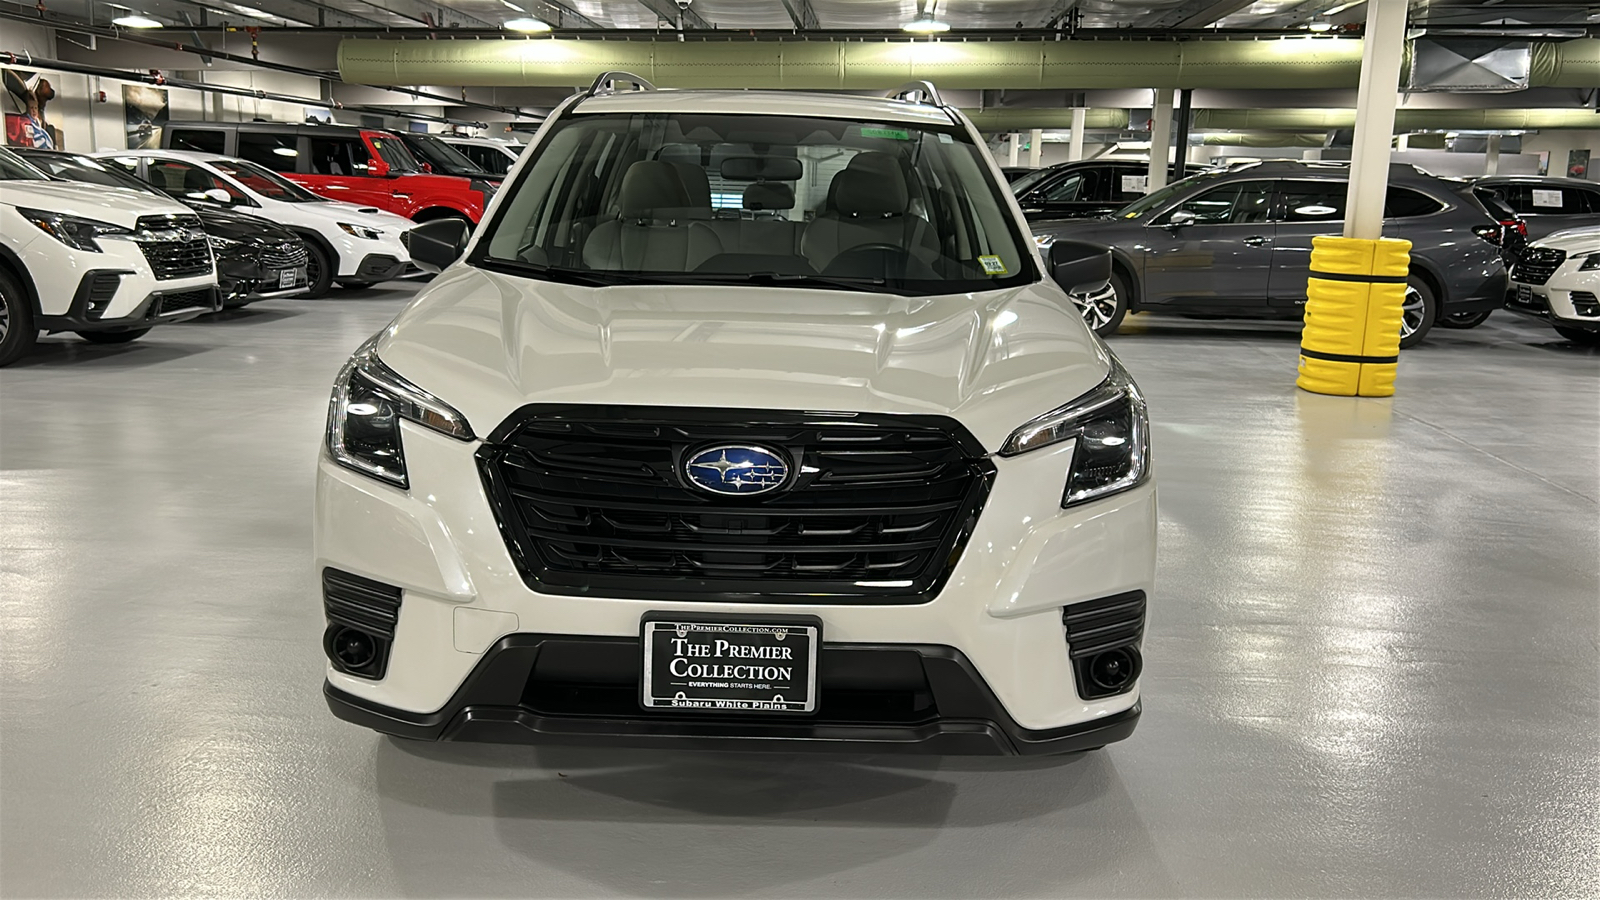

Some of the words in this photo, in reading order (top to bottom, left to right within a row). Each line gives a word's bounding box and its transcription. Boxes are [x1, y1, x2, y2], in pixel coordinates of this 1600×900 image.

[670, 638, 711, 657] THE
[714, 639, 793, 660] PREMIER
[669, 657, 793, 681] COLLECTION
[688, 681, 729, 689] EVERYTHING
[671, 700, 712, 708] Subaru
[716, 700, 749, 709] White
[752, 702, 788, 710] Plains
